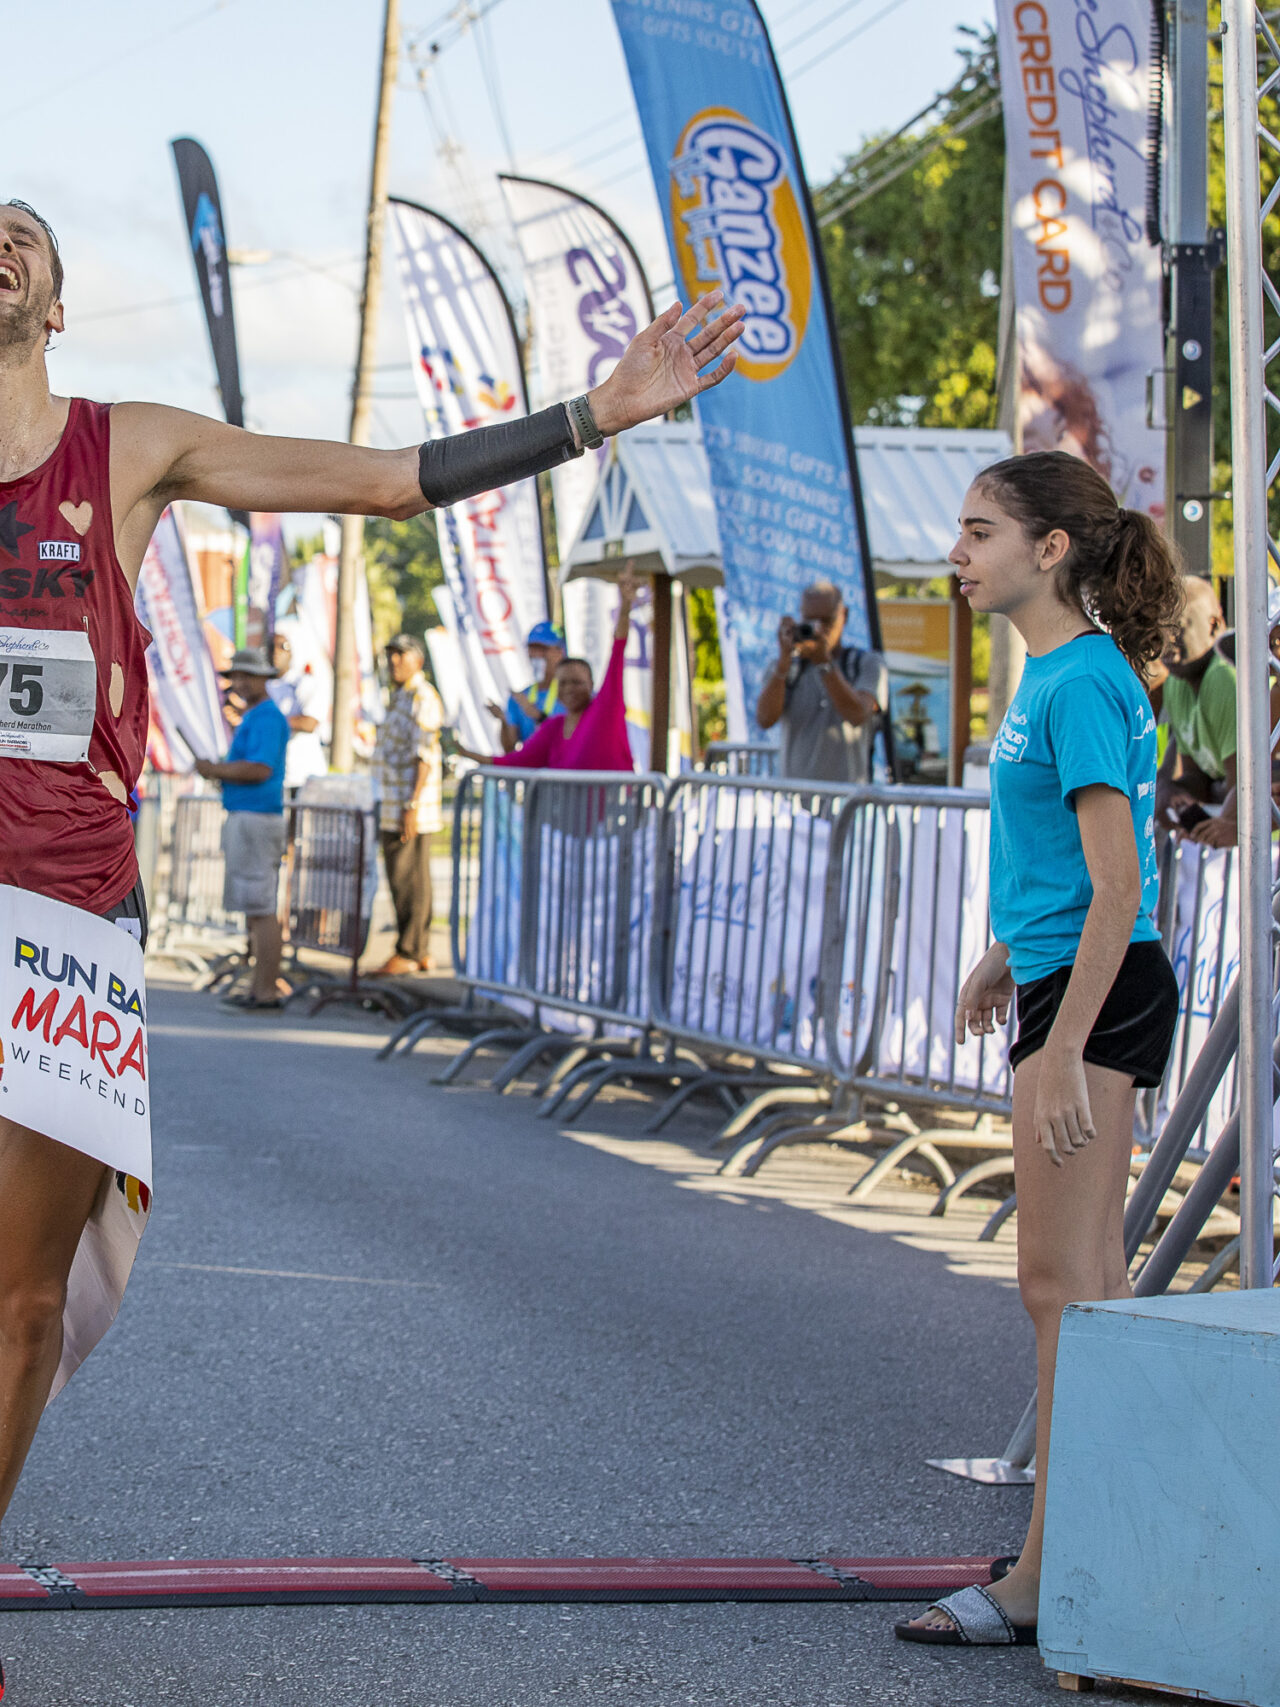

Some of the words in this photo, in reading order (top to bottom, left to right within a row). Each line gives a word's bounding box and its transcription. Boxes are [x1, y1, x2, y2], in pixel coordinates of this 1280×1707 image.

[1013, 0, 1063, 169] CREDIT
[1058, 10, 1146, 244] Shepherd
[689, 120, 792, 356] Ganzee
[1032, 178, 1072, 314] CARD
[40, 543, 79, 560] KRAFT.
[17, 721, 52, 731] Marathon
[14, 936, 97, 994] RUN
[107, 972, 145, 1026] BA
[11, 987, 146, 1081] MARA
[11, 1042, 145, 1116] WEEKEND
